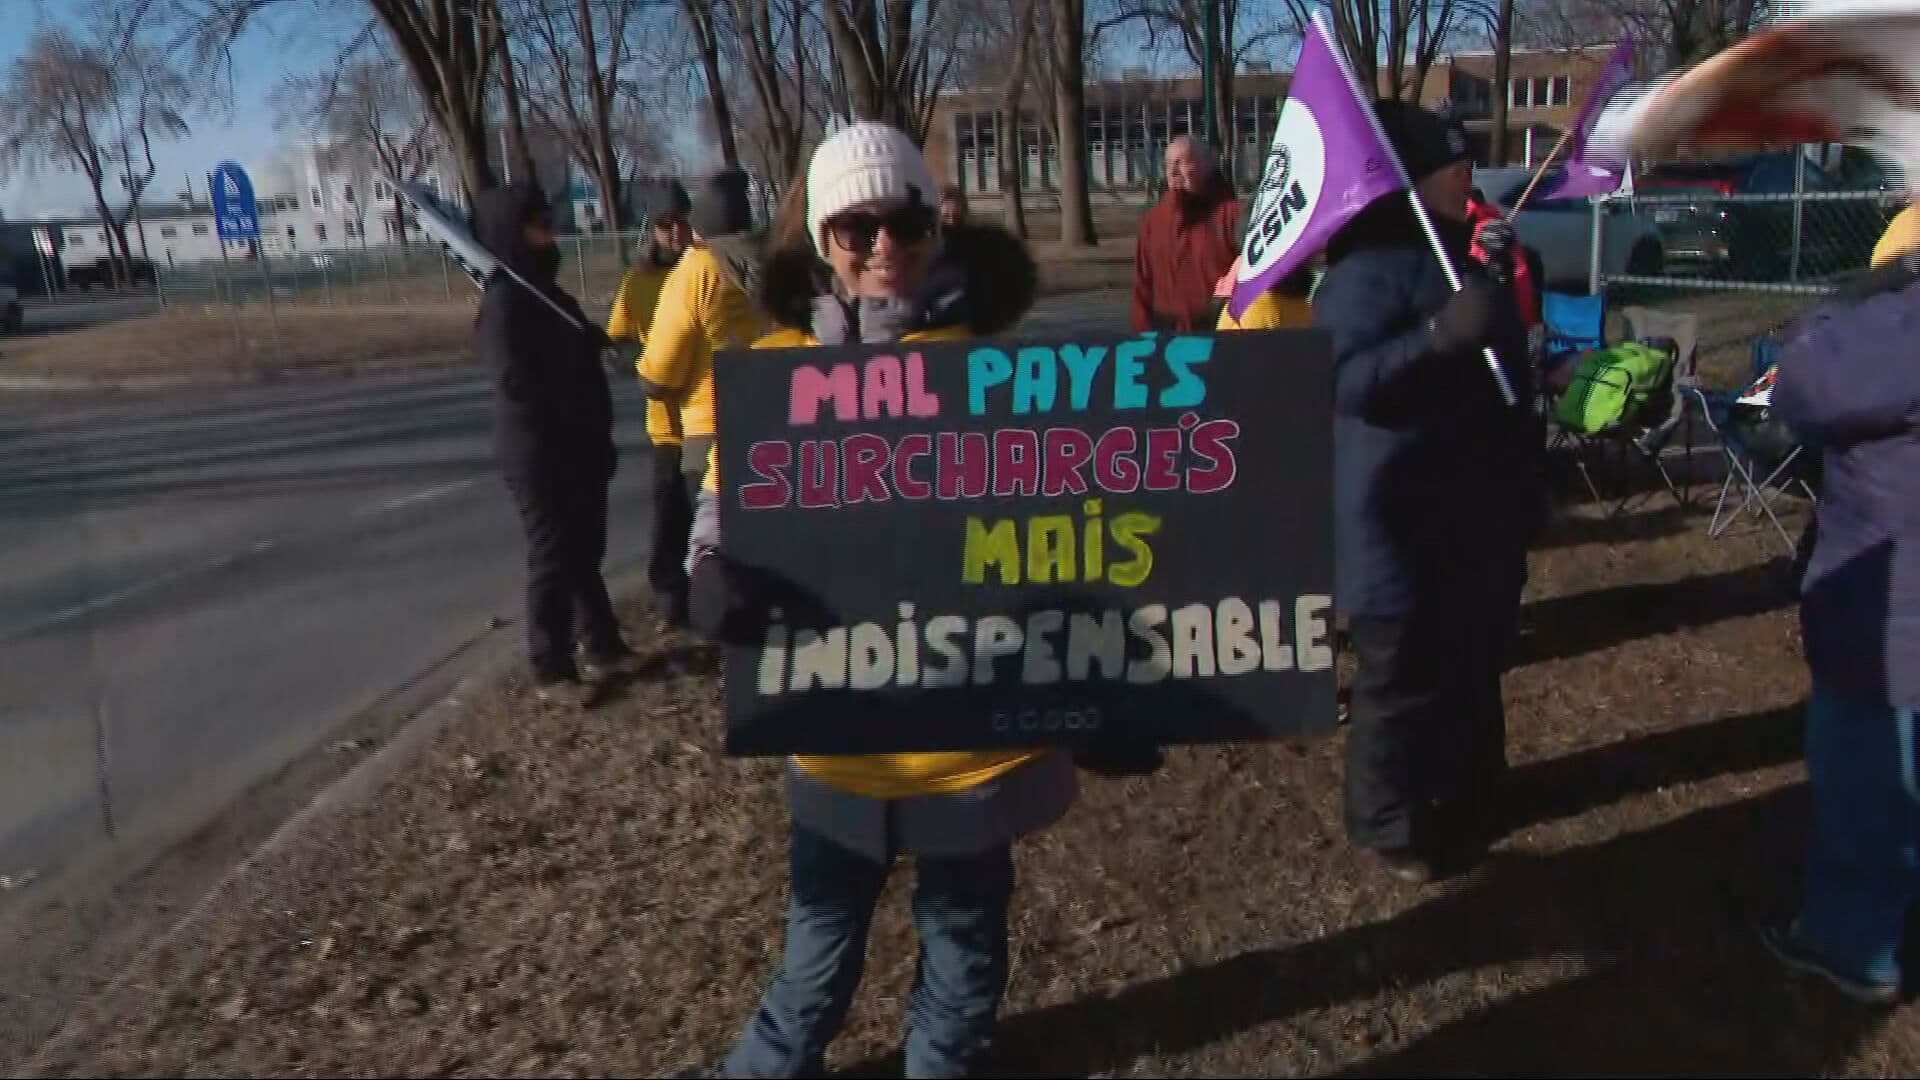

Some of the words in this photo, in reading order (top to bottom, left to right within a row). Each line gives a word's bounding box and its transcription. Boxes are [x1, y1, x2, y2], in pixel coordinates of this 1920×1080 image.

[1247, 179, 1308, 267] CSN
[788, 352, 940, 425] MAL
[966, 332, 1216, 416] PAYÉS
[739, 412, 1241, 510] SURCHARGÉS
